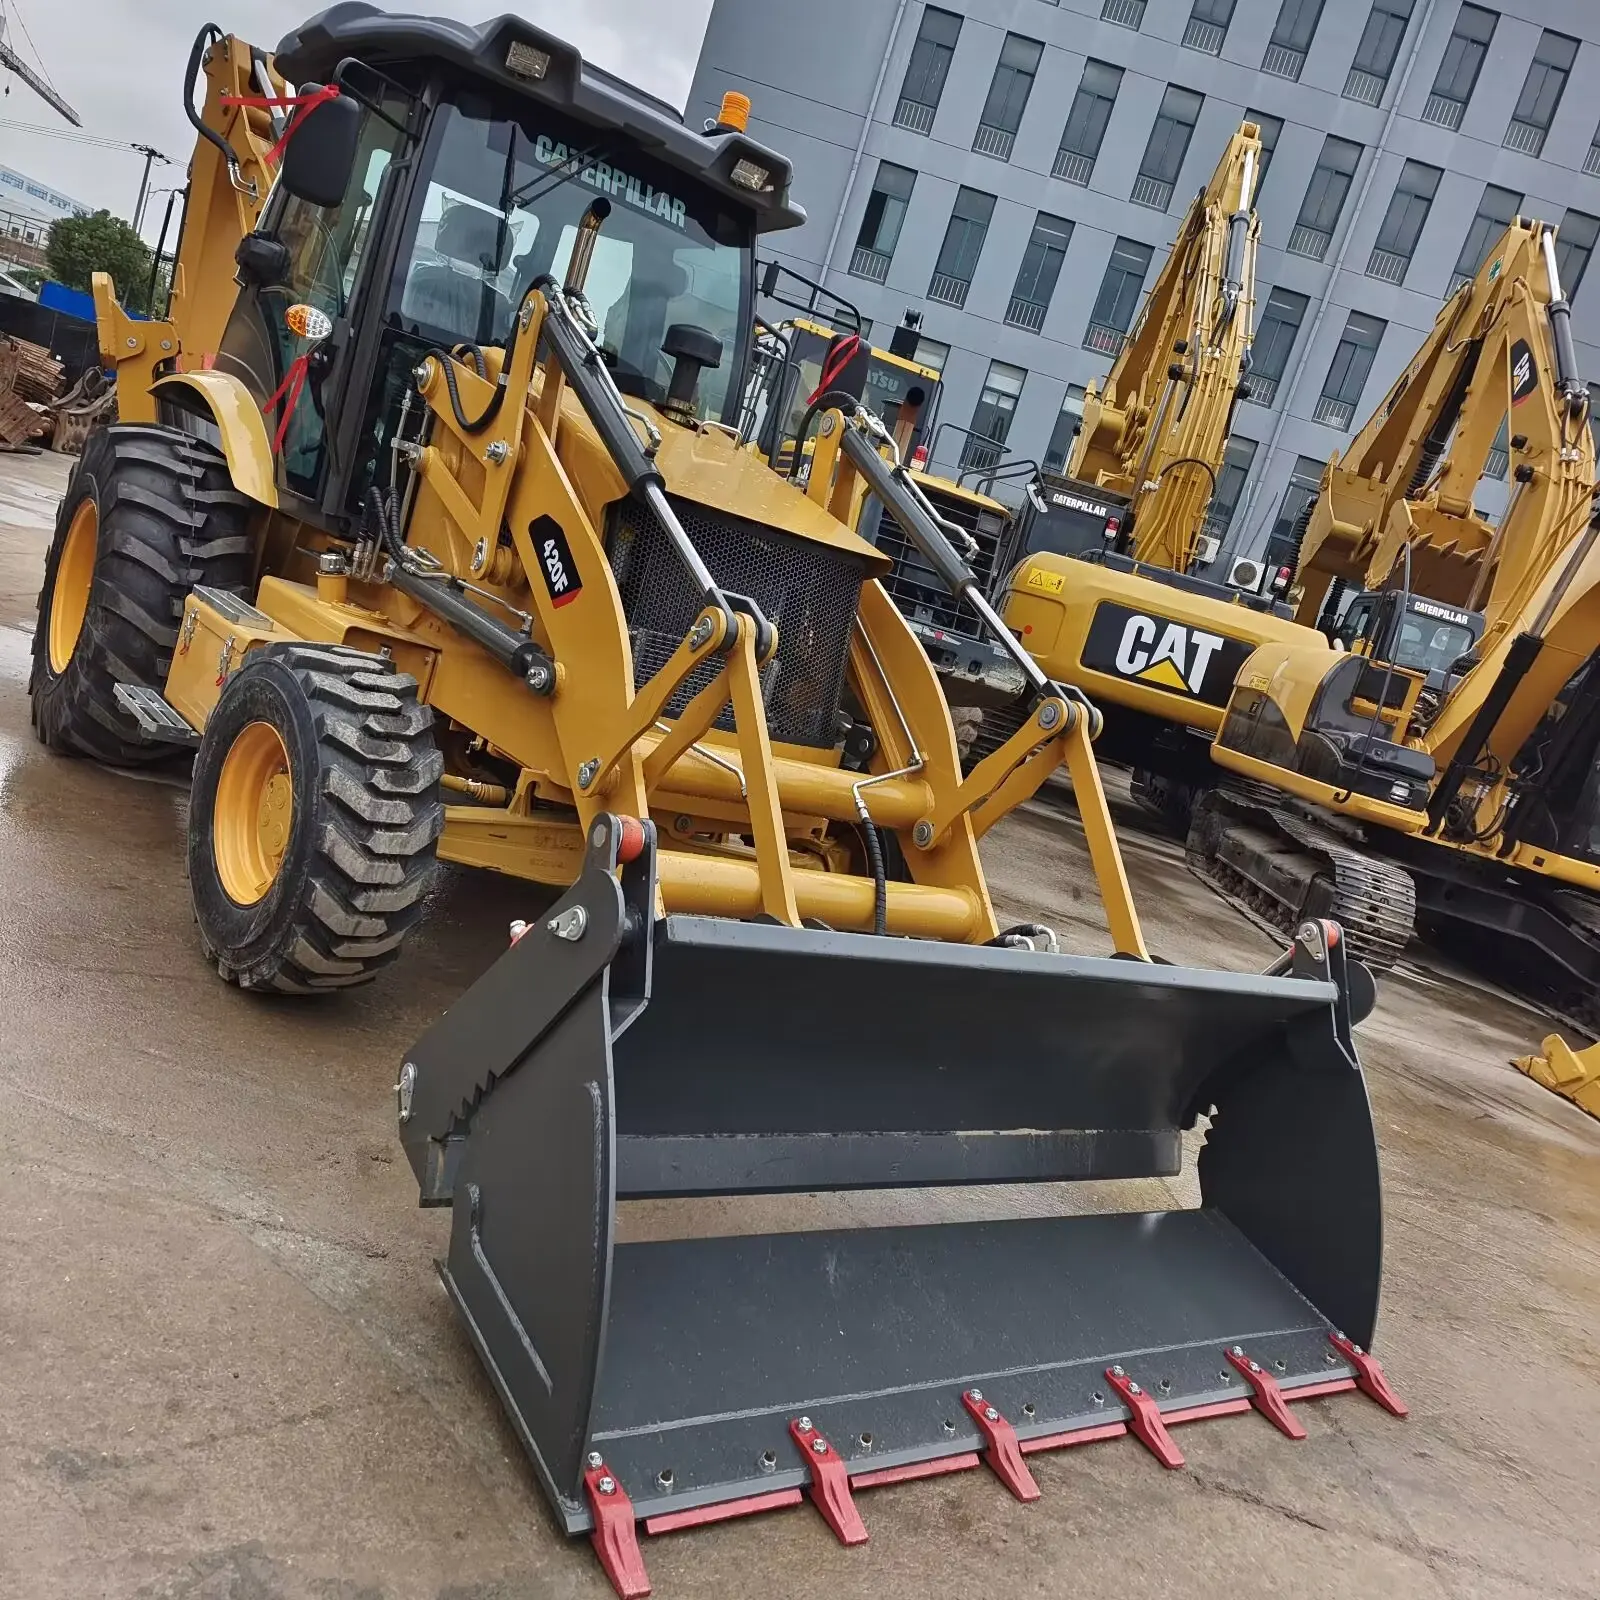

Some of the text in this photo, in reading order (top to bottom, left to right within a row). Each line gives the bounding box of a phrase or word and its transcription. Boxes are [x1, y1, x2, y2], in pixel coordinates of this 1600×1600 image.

[535, 134, 686, 228] CATERPILLAR
[1053, 493, 1107, 516] CATERPILLAR
[543, 539, 569, 592] 420F
[1414, 601, 1469, 624] CATERPILLAR
[1115, 615, 1225, 694] CAT
